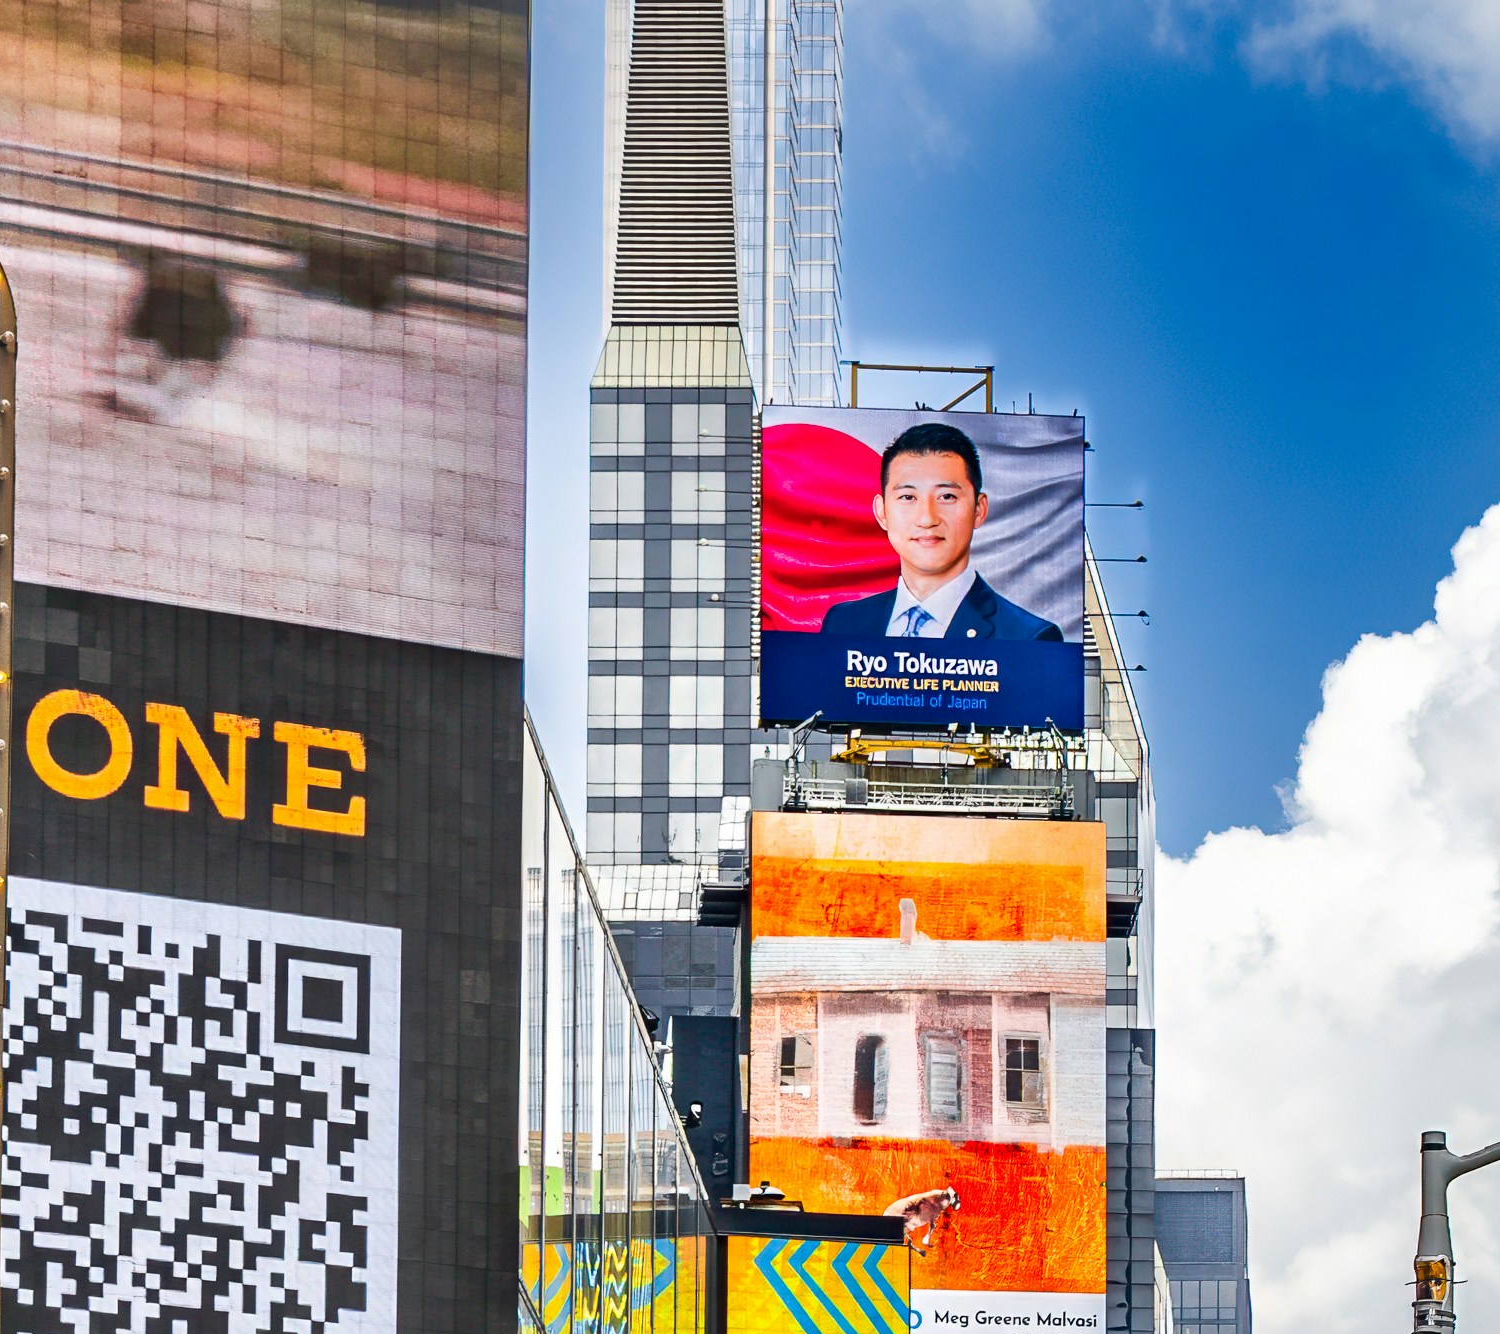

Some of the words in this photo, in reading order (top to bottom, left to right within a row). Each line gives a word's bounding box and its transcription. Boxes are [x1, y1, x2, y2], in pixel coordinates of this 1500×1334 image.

[847, 651, 887, 676] Ryo
[894, 652, 998, 676] Tokuzawa
[943, 680, 999, 692] PLANNER
[857, 693, 924, 707] Prudential
[930, 695, 943, 708] of
[948, 696, 987, 709] Japan
[26, 689, 366, 836] ONE
[935, 1311, 969, 1329] Meg
[975, 1312, 1031, 1327] Greene
[1037, 1313, 1097, 1327] Malvasi
